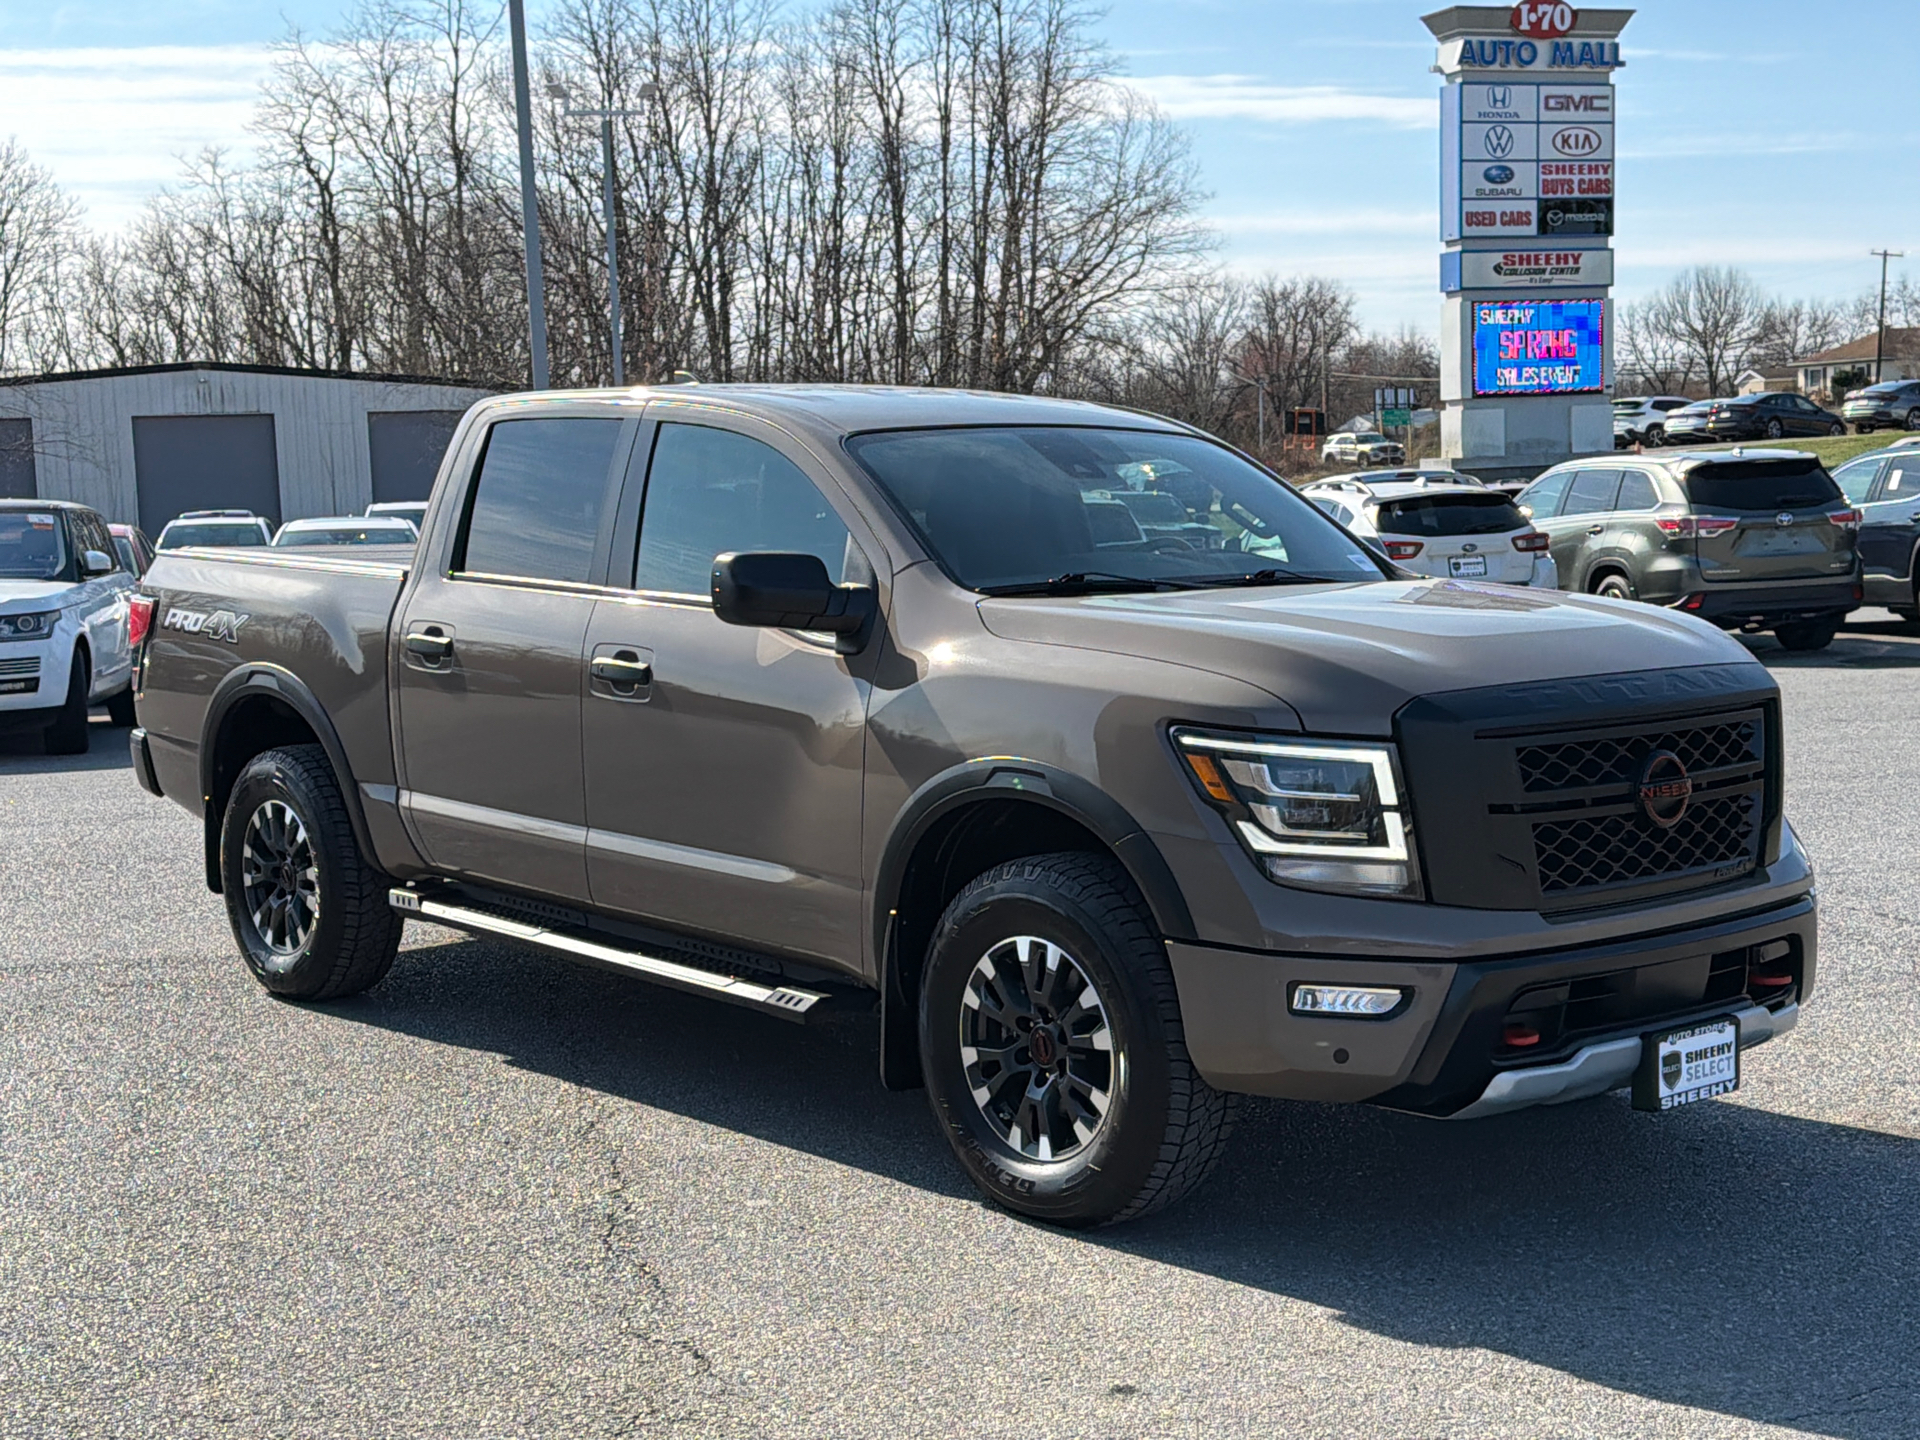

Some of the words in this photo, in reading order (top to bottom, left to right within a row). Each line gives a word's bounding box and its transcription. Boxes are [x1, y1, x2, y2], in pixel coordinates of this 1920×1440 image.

[1460, 40, 1538, 67] AUTO
[1550, 41, 1626, 67] MALL
[1544, 95, 1610, 112] GMC
[1561, 134, 1593, 150] KIA
[1541, 164, 1611, 176] SHEEHY
[1475, 188, 1522, 197] SUBARU
[1542, 178, 1573, 196] BUYS
[1578, 178, 1611, 195] CARS
[1465, 211, 1496, 227] USED
[1500, 210, 1532, 226] CARS
[1502, 253, 1582, 266] SHEEHY
[1503, 267, 1547, 276] COLLISION
[1548, 266, 1581, 276] CENTER
[1480, 308, 1535, 325] SHEEHY
[1499, 329, 1577, 360] SPRING
[1496, 367, 1540, 386] SALES
[1504, 668, 1745, 708] TITAN
[1667, 1030, 1691, 1042] AUTO
[1694, 1021, 1730, 1037] STORES
[1685, 1041, 1733, 1064] SHEEHY
[1686, 1056, 1733, 1082] SELECT
[1661, 1079, 1737, 1110] SHEEHY
